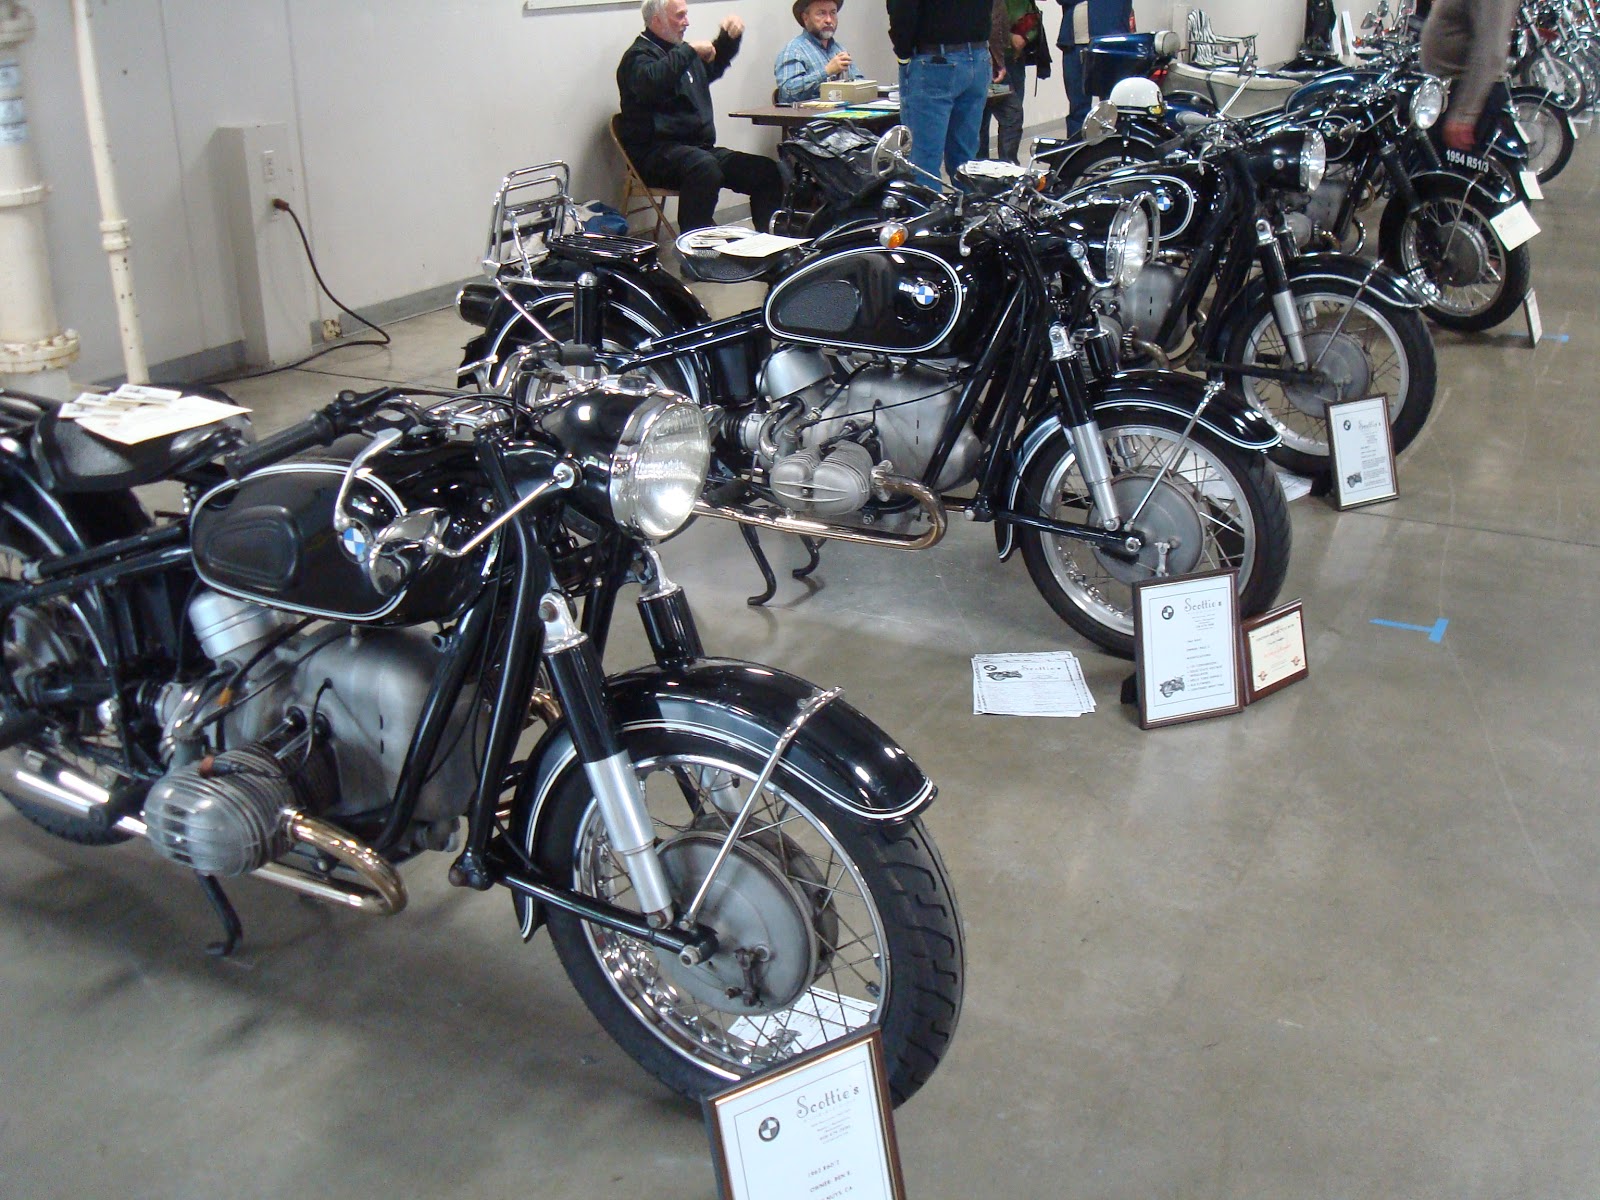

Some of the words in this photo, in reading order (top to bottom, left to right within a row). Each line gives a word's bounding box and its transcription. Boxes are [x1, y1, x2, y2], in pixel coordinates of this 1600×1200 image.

[1446, 150, 1465, 166] 1954
[1466, 156, 1489, 173] R51/3
[796, 1084, 860, 1119] Scottie's
